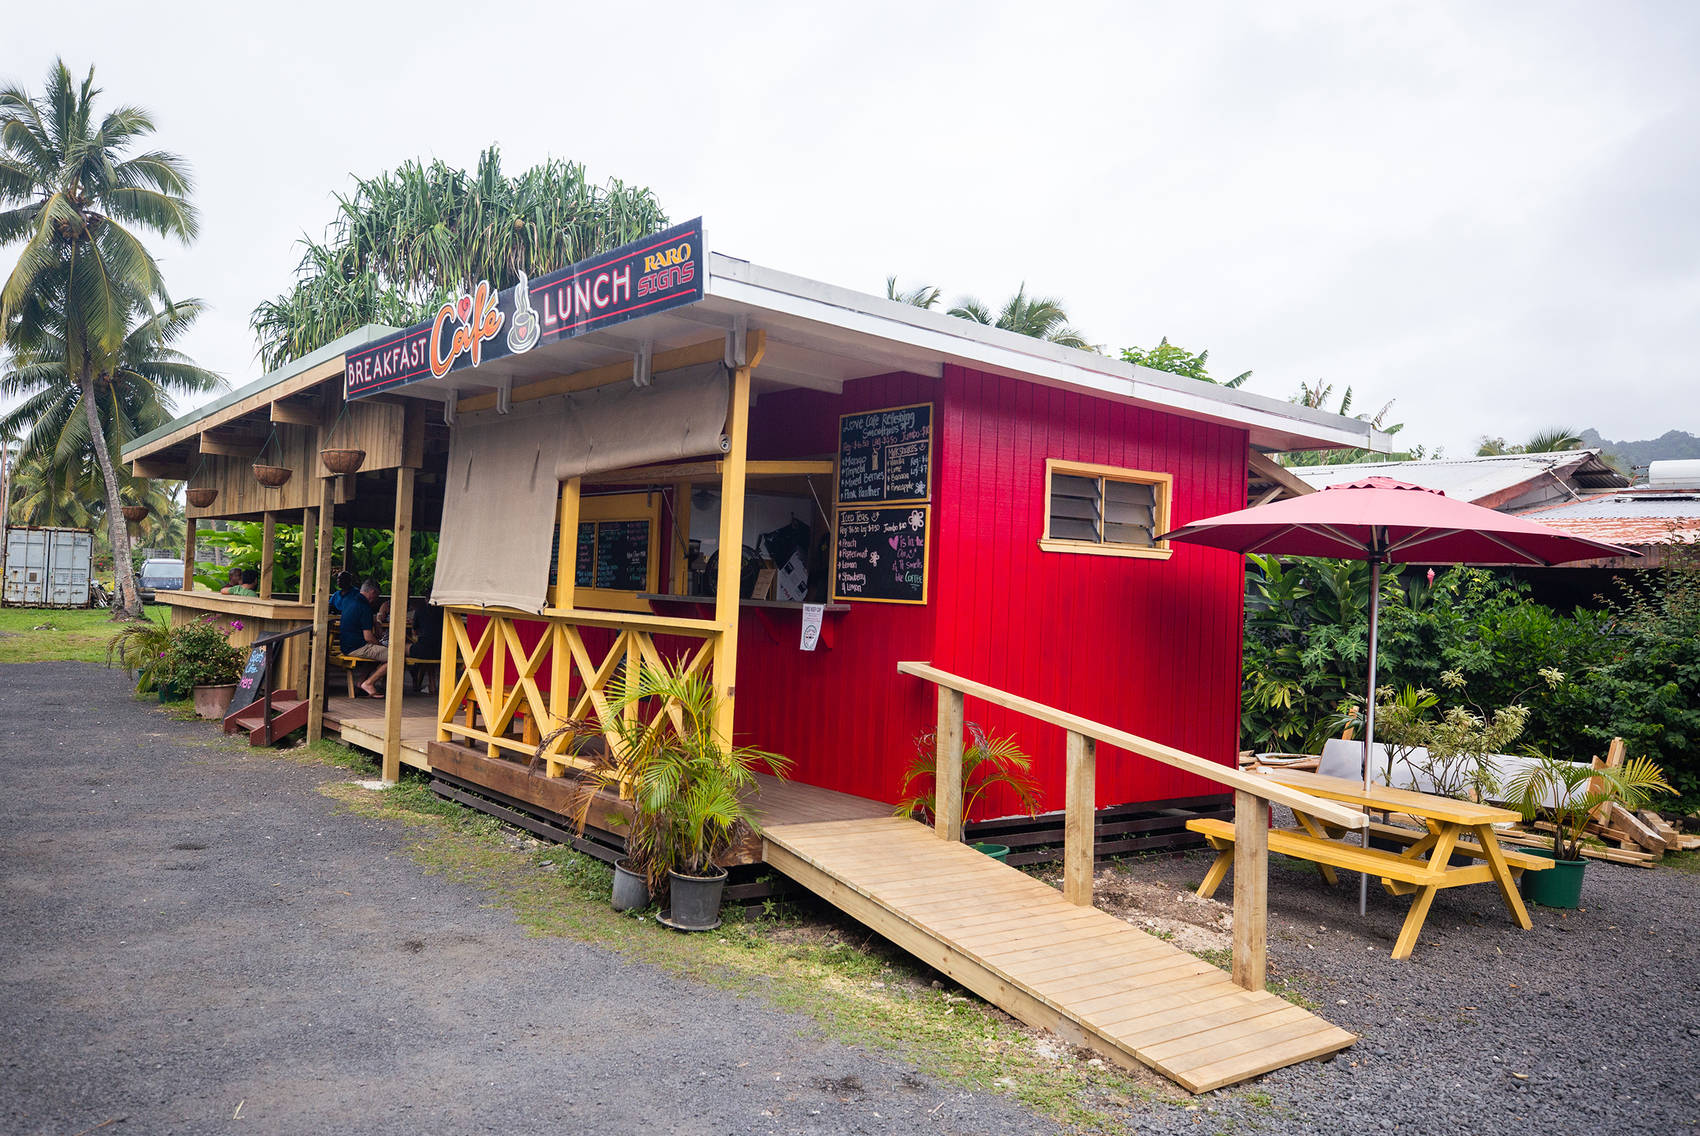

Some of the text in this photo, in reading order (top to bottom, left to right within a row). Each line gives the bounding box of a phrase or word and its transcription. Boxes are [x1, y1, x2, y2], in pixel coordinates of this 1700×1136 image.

[644, 243, 692, 274] RARO
[638, 260, 695, 298] SIGNS
[348, 264, 631, 388] BREAKFAST Café LUNCH
